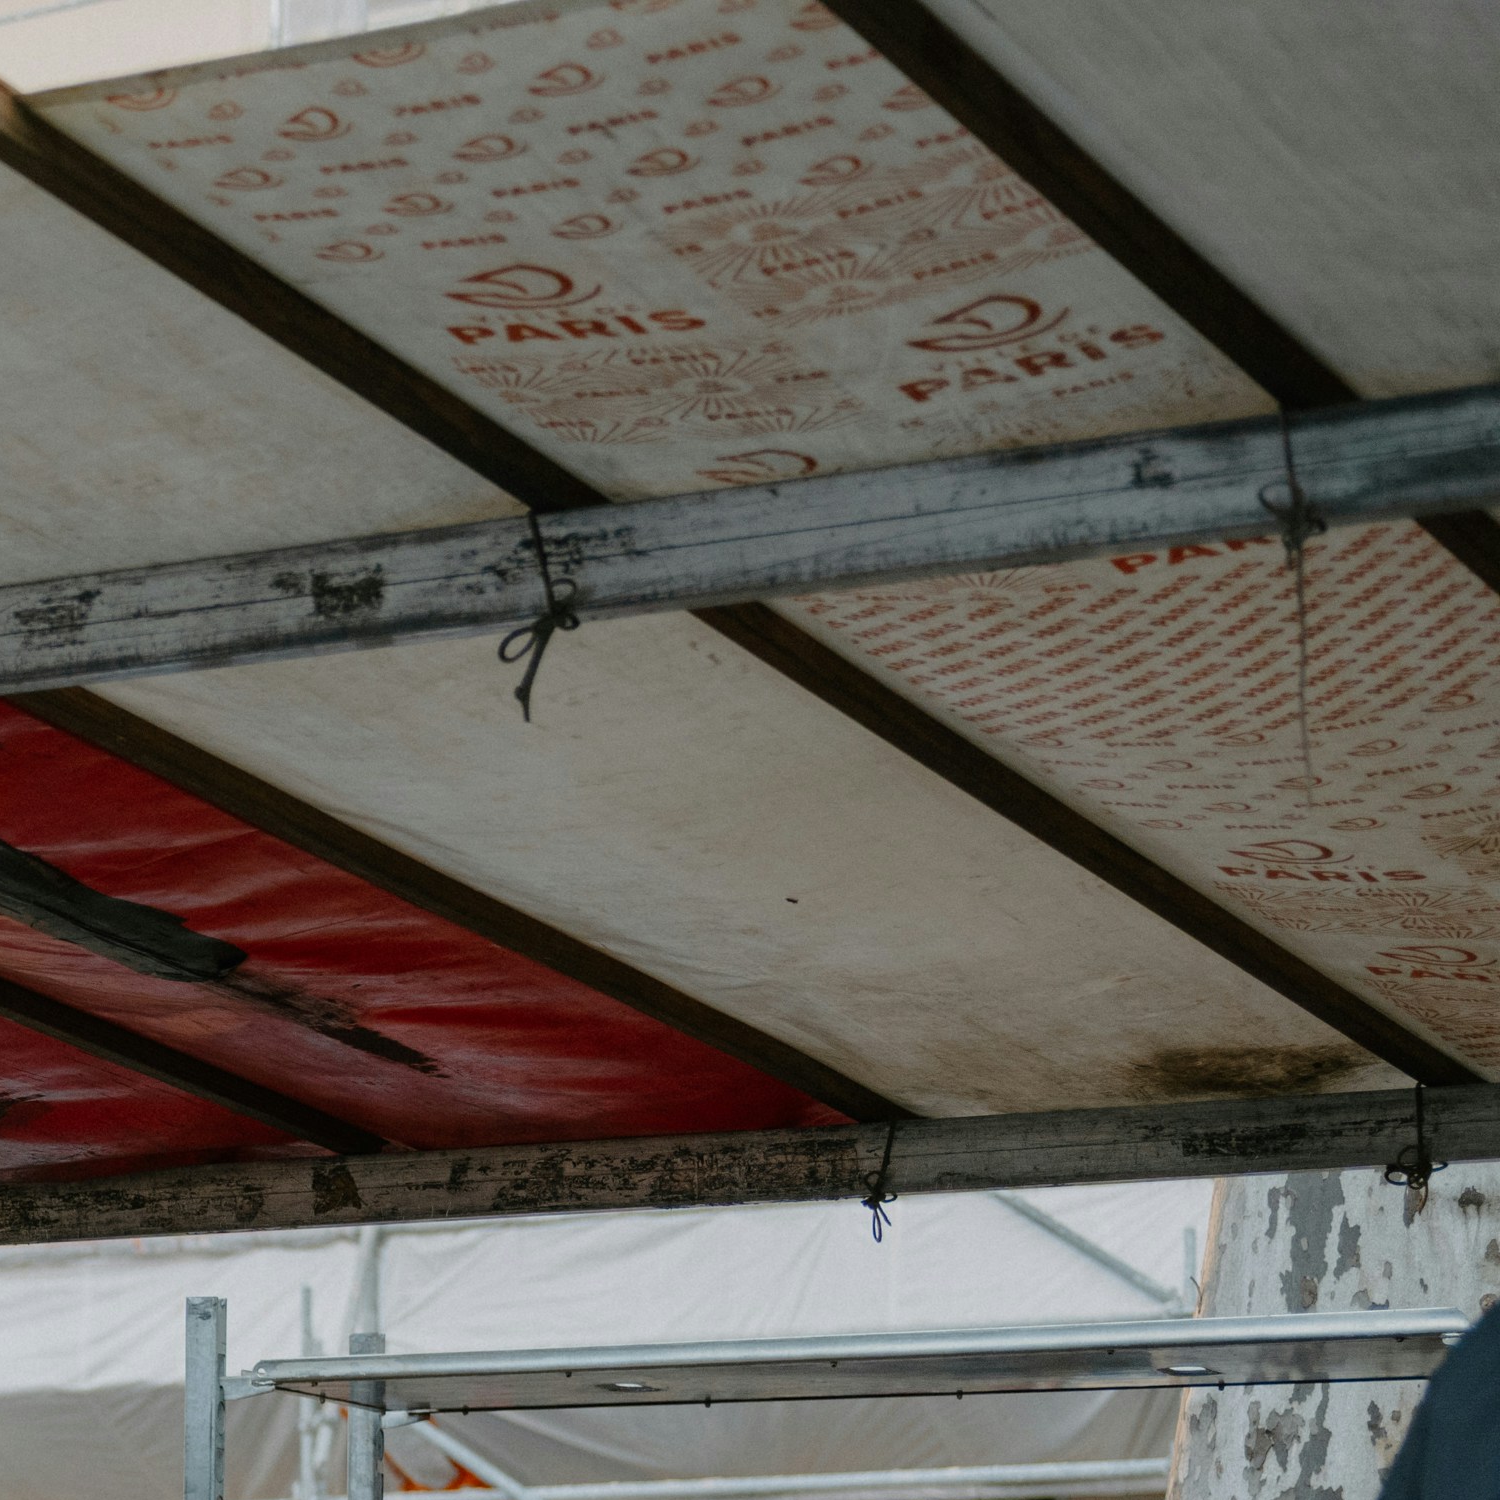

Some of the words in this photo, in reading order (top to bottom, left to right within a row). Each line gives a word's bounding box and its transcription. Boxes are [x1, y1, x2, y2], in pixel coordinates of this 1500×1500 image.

[445, 310, 706, 345] PARIS
[899, 325, 1165, 401] PARIS
[1215, 864, 1427, 883] PARIS
